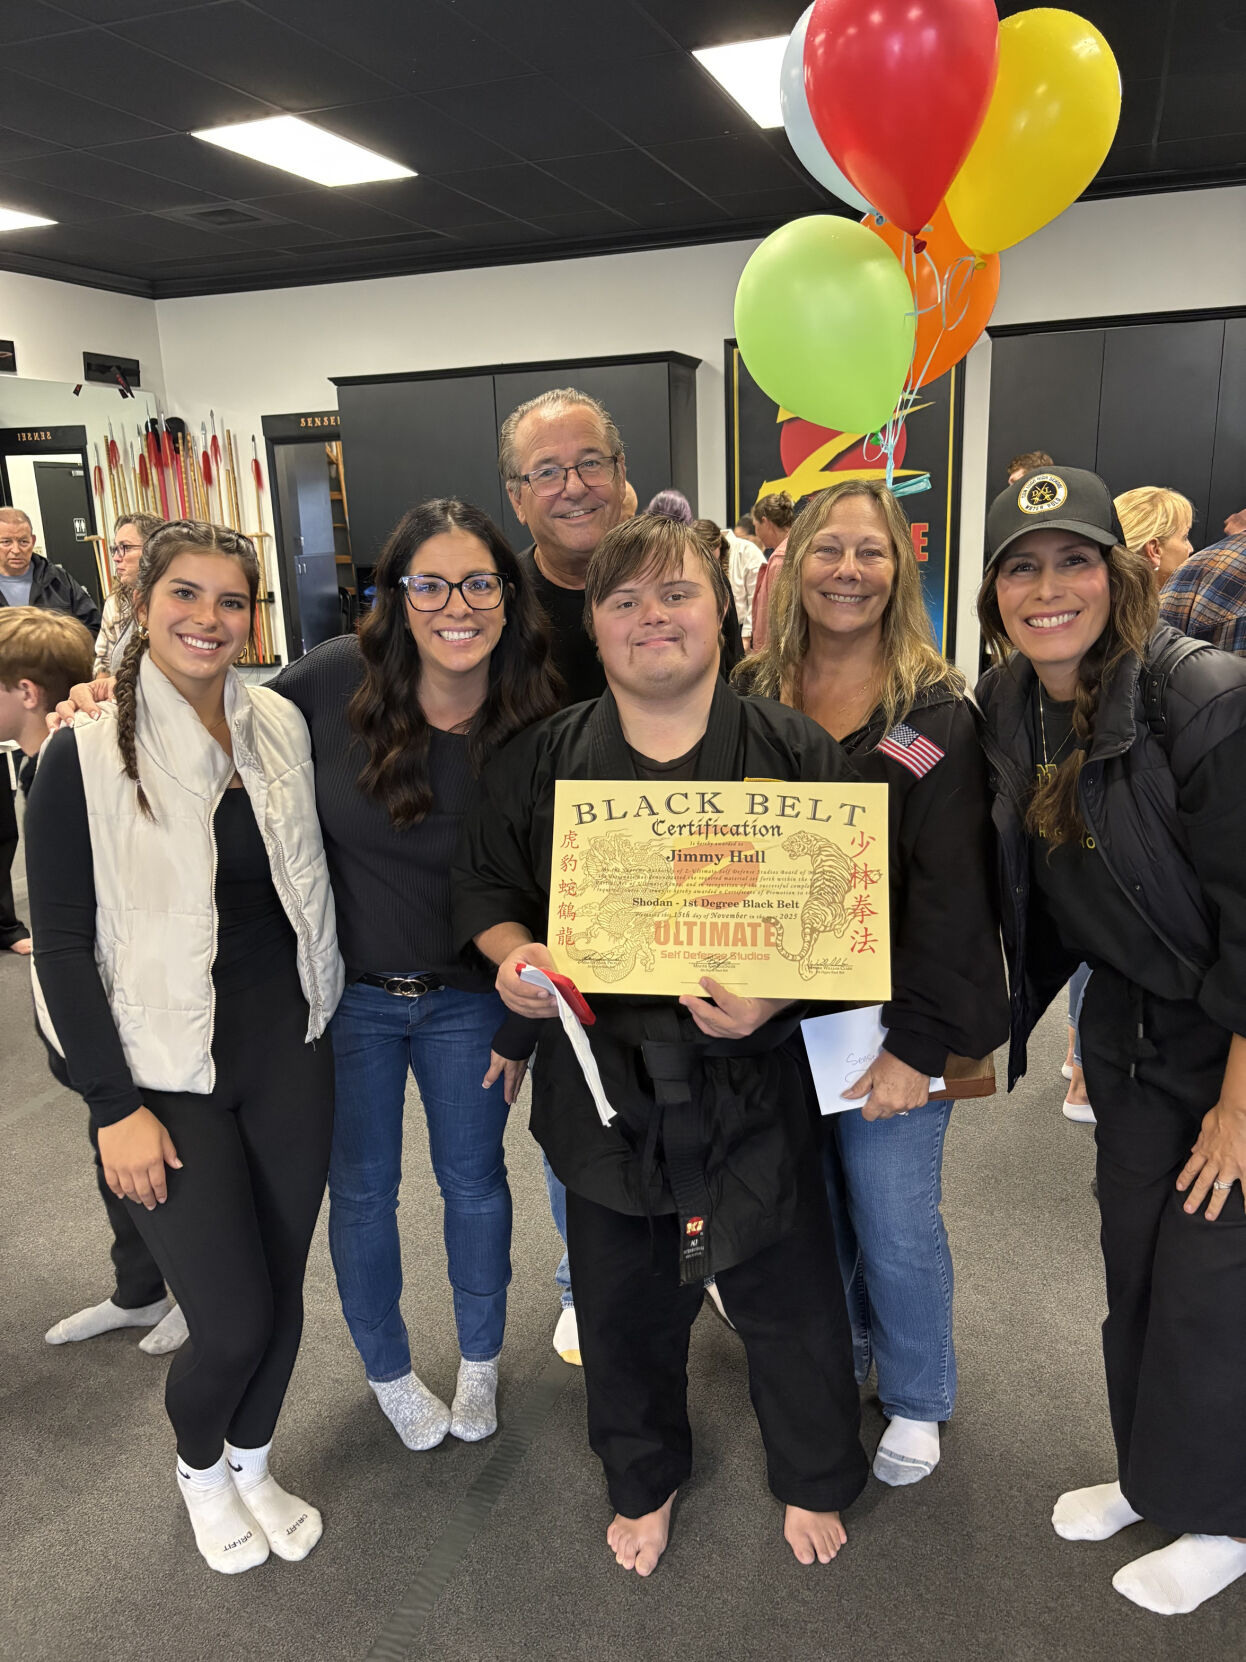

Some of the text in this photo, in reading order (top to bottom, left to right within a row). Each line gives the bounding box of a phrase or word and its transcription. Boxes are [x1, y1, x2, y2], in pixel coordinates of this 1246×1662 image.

[571, 792, 866, 828] BLACK BELT
[651, 817, 783, 840] Certification
[666, 849, 766, 866] Jimmy Hull
[632, 897, 673, 907] Shodan
[683, 898, 698, 907] 1st
[701, 898, 740, 910] Degree
[742, 899, 775, 909] Black
[777, 899, 799, 909] Belt
[710, 911, 748, 919] November
[654, 920, 777, 948] ULTIMATE
[660, 950, 771, 961] Self Defense Studios
[286, 1513, 308, 1536] DRI-FIT
[223, 1530, 253, 1552] DRI-FIT
